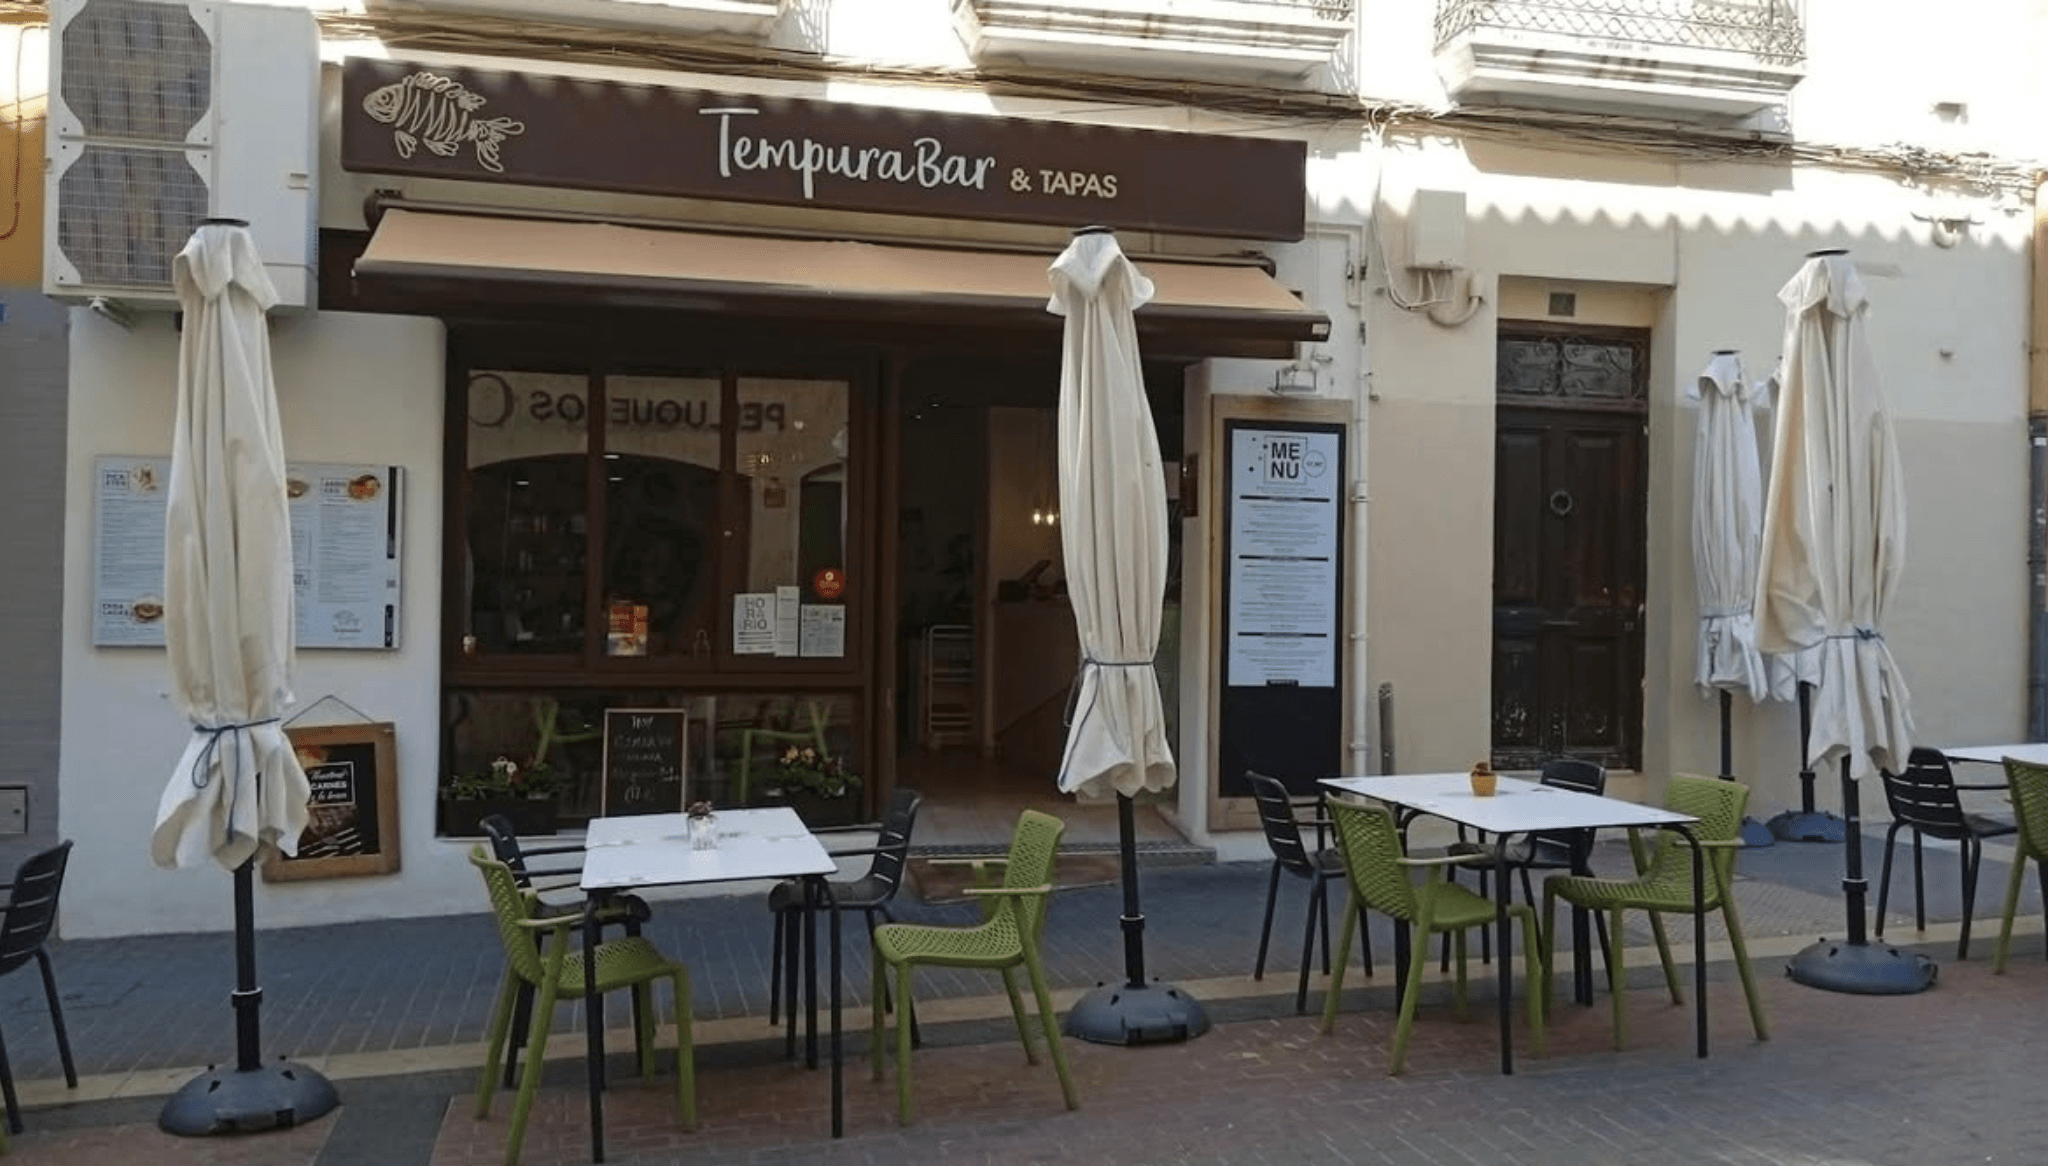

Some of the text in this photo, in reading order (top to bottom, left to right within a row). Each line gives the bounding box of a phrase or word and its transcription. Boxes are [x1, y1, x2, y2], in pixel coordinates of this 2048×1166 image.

[1009, 168, 1032, 192] &
[1039, 170, 1118, 198] TAPAS
[1271, 442, 1301, 460] ME
[1271, 461, 1300, 479] NU
[743, 619, 768, 630] RIO
